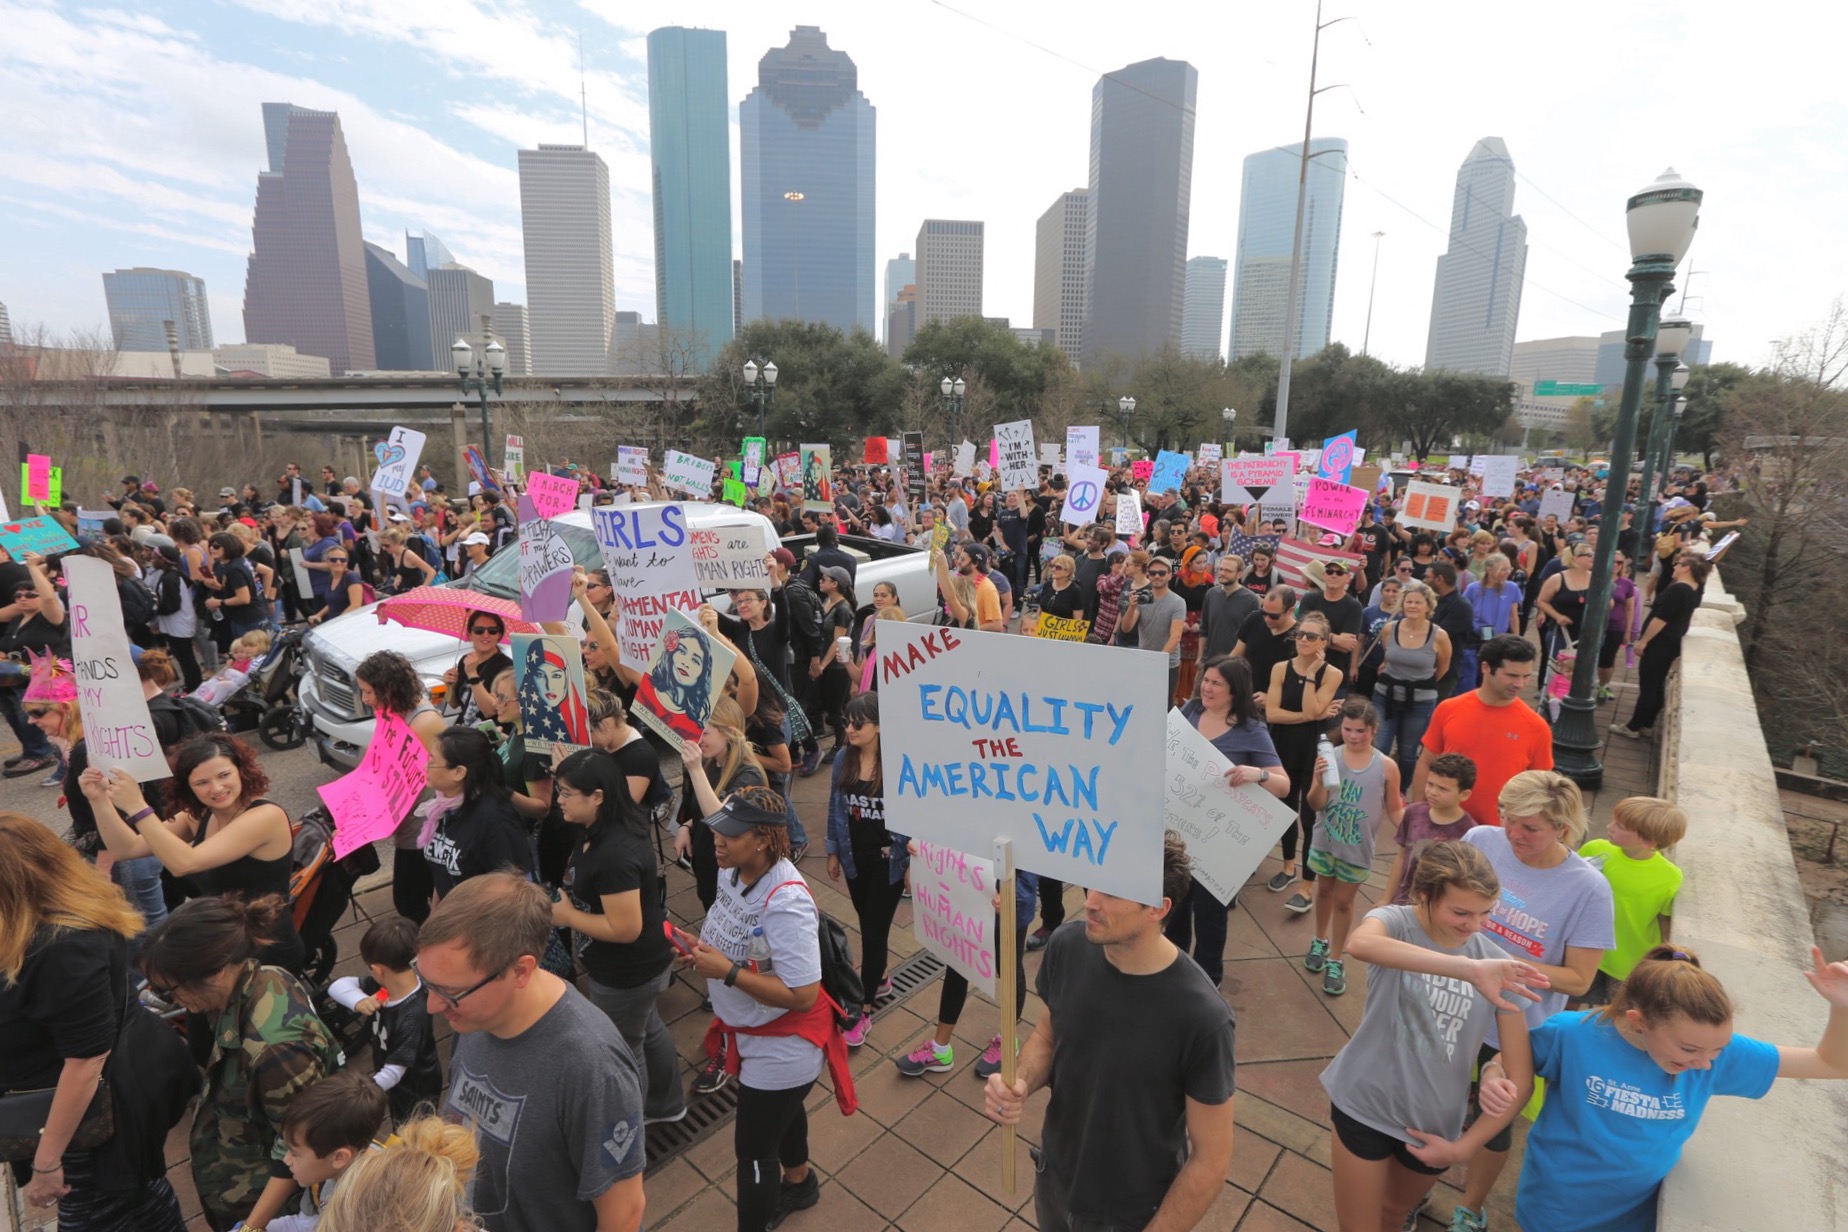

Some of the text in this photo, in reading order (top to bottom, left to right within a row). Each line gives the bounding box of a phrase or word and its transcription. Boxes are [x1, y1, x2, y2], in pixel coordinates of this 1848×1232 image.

[396, 430, 407, 443] I
[1008, 441, 1021, 451] I'M
[676, 454, 714, 473] BRIDGES
[1005, 452, 1028, 461] WITH
[1009, 461, 1026, 471] HER
[1226, 460, 1288, 470] THE PATRIARCHY
[378, 474, 405, 492] IUD
[667, 473, 683, 484] NOT
[686, 476, 710, 492] WALLS
[1231, 470, 1238, 478] IS
[1248, 470, 1284, 478] PYRAMID
[1237, 478, 1277, 486] SCHEME
[1315, 481, 1352, 494] POWER
[538, 493, 560, 509] FOR
[1305, 505, 1361, 520] FEMINARCHY
[688, 530, 720, 545] MEN'S
[727, 539, 750, 550] are
[521, 541, 551, 558] FF my
[692, 546, 719, 560] GHTS
[523, 546, 571, 589] DRAWERS
[646, 551, 675, 568] to
[694, 558, 770, 581] UMAN RIGHTS
[616, 589, 703, 616] DAMENTAL
[1038, 627, 1059, 640] JUST
[1044, 616, 1079, 633] GIRLS
[620, 636, 656, 662] RIGH
[883, 627, 961, 685] MAKE
[83, 687, 103, 708] MY
[918, 683, 1134, 746] EQUALITY
[87, 711, 155, 758] RIGHTS
[663, 727, 683, 745] PEOPL
[972, 737, 1024, 759] THE
[398, 733, 425, 796] Future
[898, 754, 1101, 812] AMERICAN
[844, 794, 884, 809] AST
[1164, 808, 1219, 844] OTERS!
[1032, 812, 1118, 866] WAY
[916, 882, 984, 943] HUMAN
[1506, 907, 1549, 939] HOPE
[716, 933, 748, 957] NEFERTIT
[923, 914, 993, 979] RIGHTS
[1497, 926, 1503, 934] A
[1503, 929, 1533, 949] REASON
[1427, 984, 1472, 1020] OUR
[1588, 1077, 1605, 1092] 16
[459, 1080, 503, 1125] SAINTS
[1604, 1085, 1661, 1109] FIESTA
[1610, 1100, 1686, 1120] MADNESS
